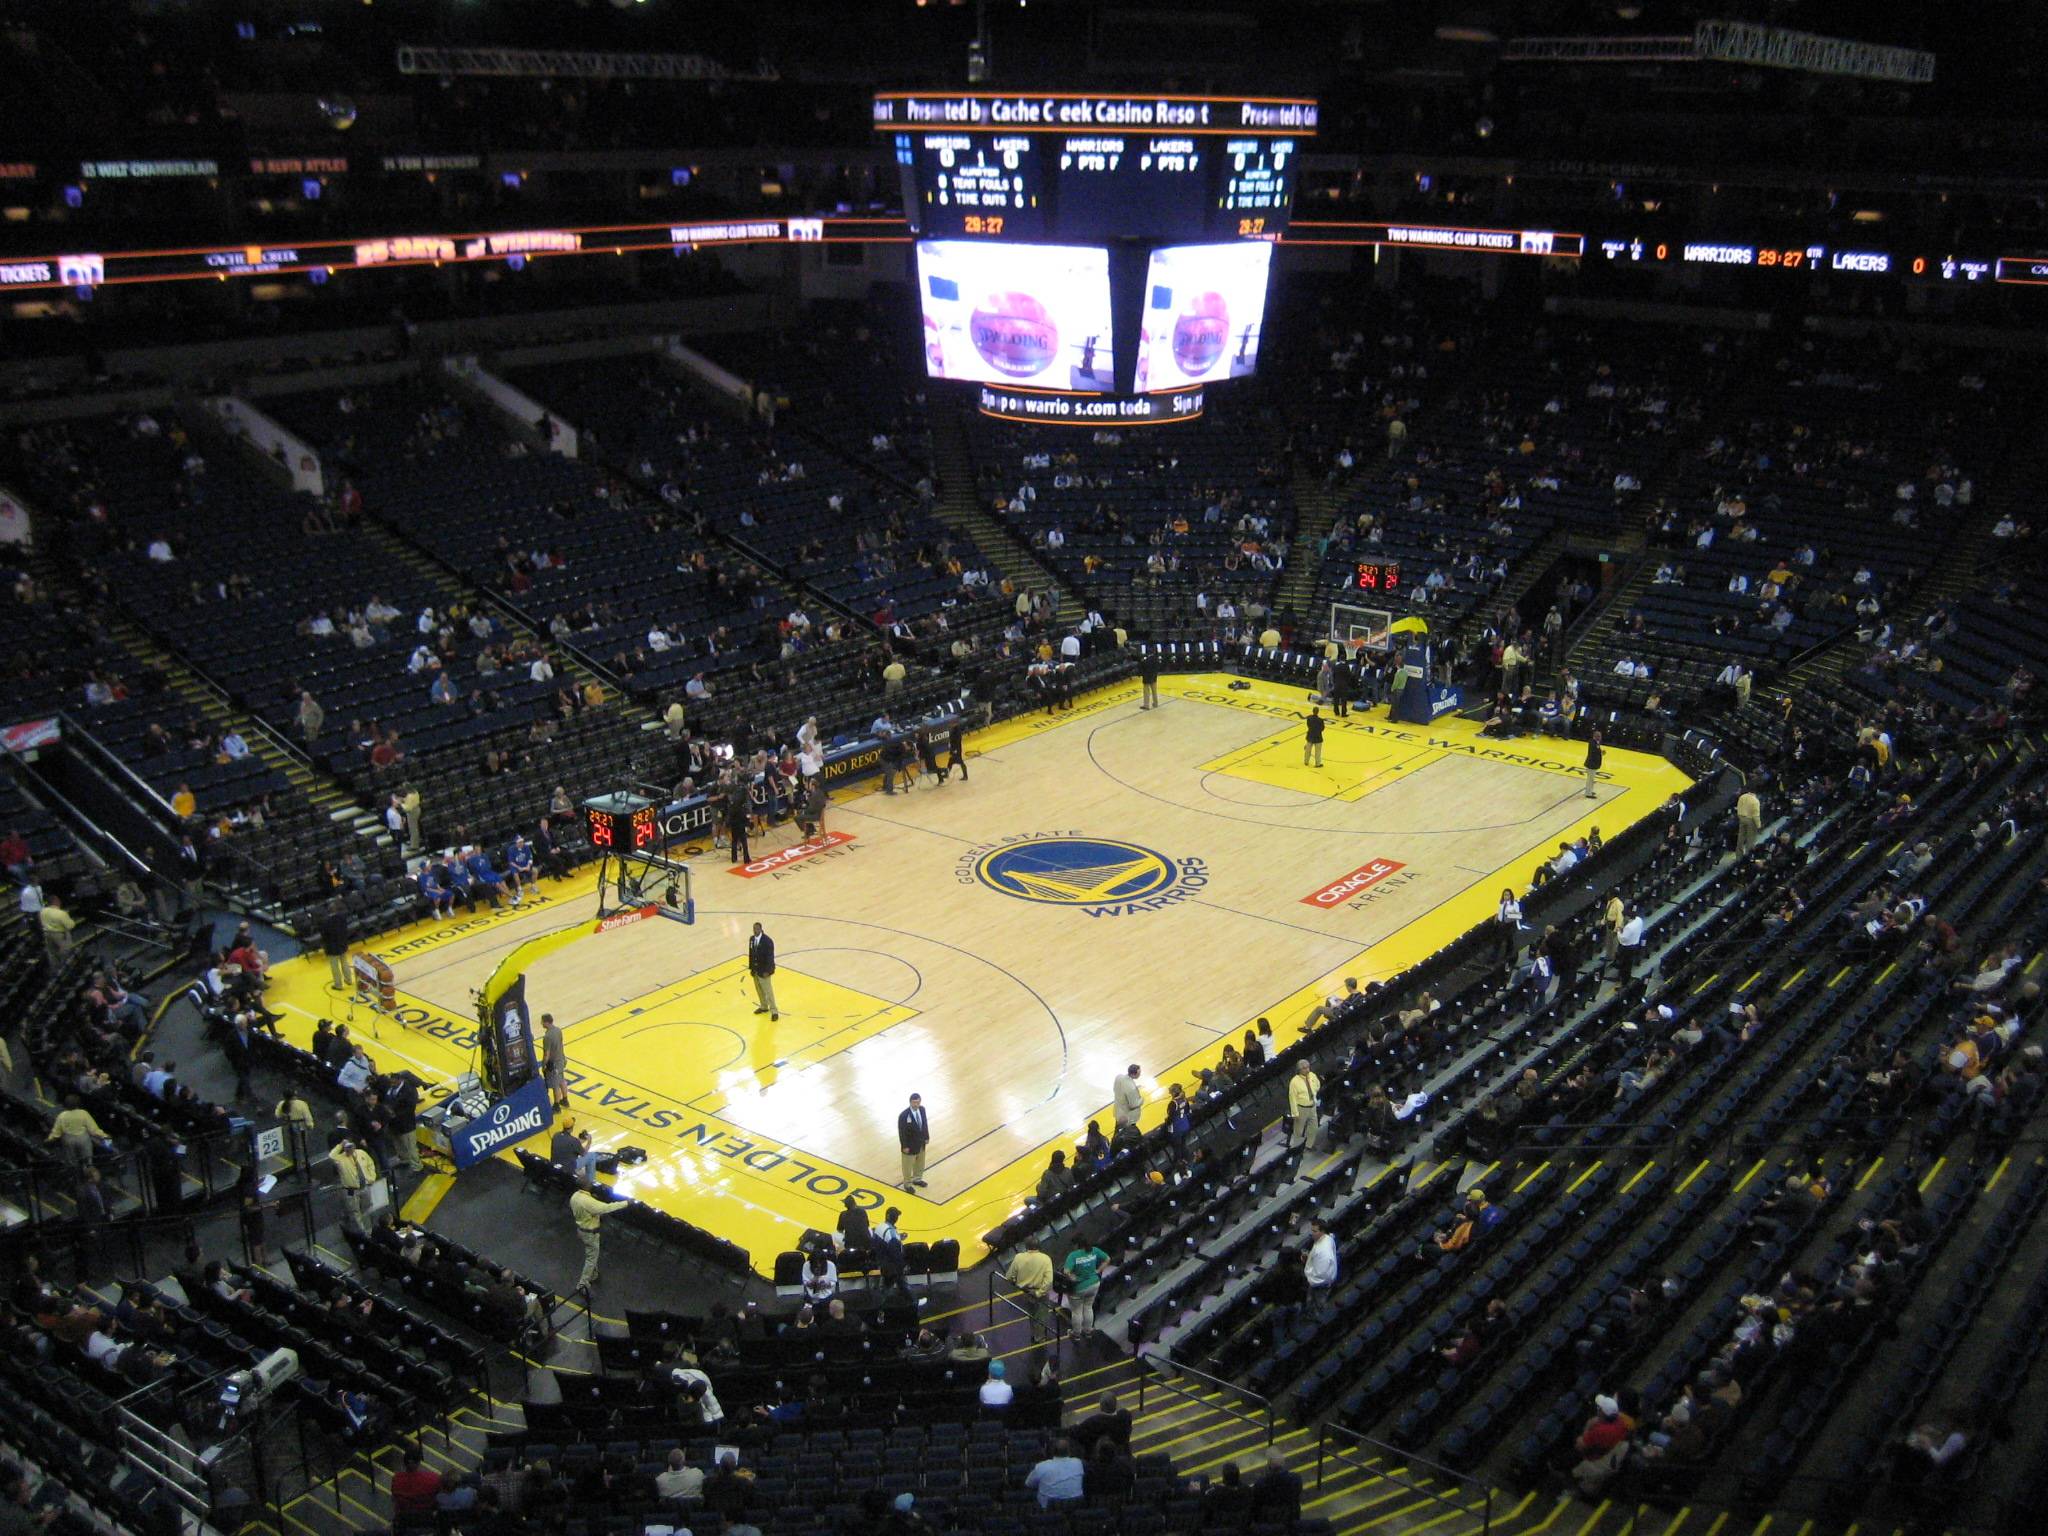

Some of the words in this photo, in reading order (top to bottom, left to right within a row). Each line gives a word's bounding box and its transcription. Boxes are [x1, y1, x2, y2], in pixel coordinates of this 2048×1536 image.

[991, 98, 1040, 122] Cache
[1043, 99, 1093, 122] Ceek
[1095, 99, 1153, 124] Casino
[1156, 100, 1209, 124] Resot
[1066, 138, 1124, 152] WARRIORS
[1150, 139, 1194, 153] LAKERS
[940, 149, 955, 167] 0
[1003, 150, 1019, 169] 0
[1078, 154, 1105, 171] PTS
[1158, 155, 1185, 171] PTS
[1387, 228, 1407, 242] TWO
[1408, 229, 1454, 245] WARRIORS
[1455, 232, 1477, 246] CLUB
[1478, 233, 1514, 248] TICKETS
[1684, 246, 1752, 264] WARRIORS
[1757, 250, 1803, 267] 29:27
[1832, 253, 1888, 272] LAKERS
[1025, 398, 1116, 416] warrios.com
[1120, 398, 1157, 416] toda
[1360, 573, 1375, 588] 24
[1183, 691, 1307, 719] GOLDEN
[1322, 718, 1421, 742] STATE
[1429, 738, 1614, 780] WARRIORS
[589, 811, 613, 826] 29:27
[658, 806, 712, 836] CHE
[593, 824, 612, 846] 24
[636, 822, 653, 846] 24
[745, 835, 842, 874] ORACLE
[772, 843, 865, 881] ARENA
[955, 842, 997, 885] GOLDEN
[1001, 829, 1084, 843] STATE
[1080, 856, 1210, 918] WARRIORS
[1316, 863, 1392, 903] ORACLE
[1347, 871, 1422, 911] ARENA
[374, 895, 554, 962] ARRIORS.COM
[469, 1106, 543, 1156] SPALDING
[263, 1139, 280, 1155] 22
[677, 1122, 886, 1211] GOLDEN
